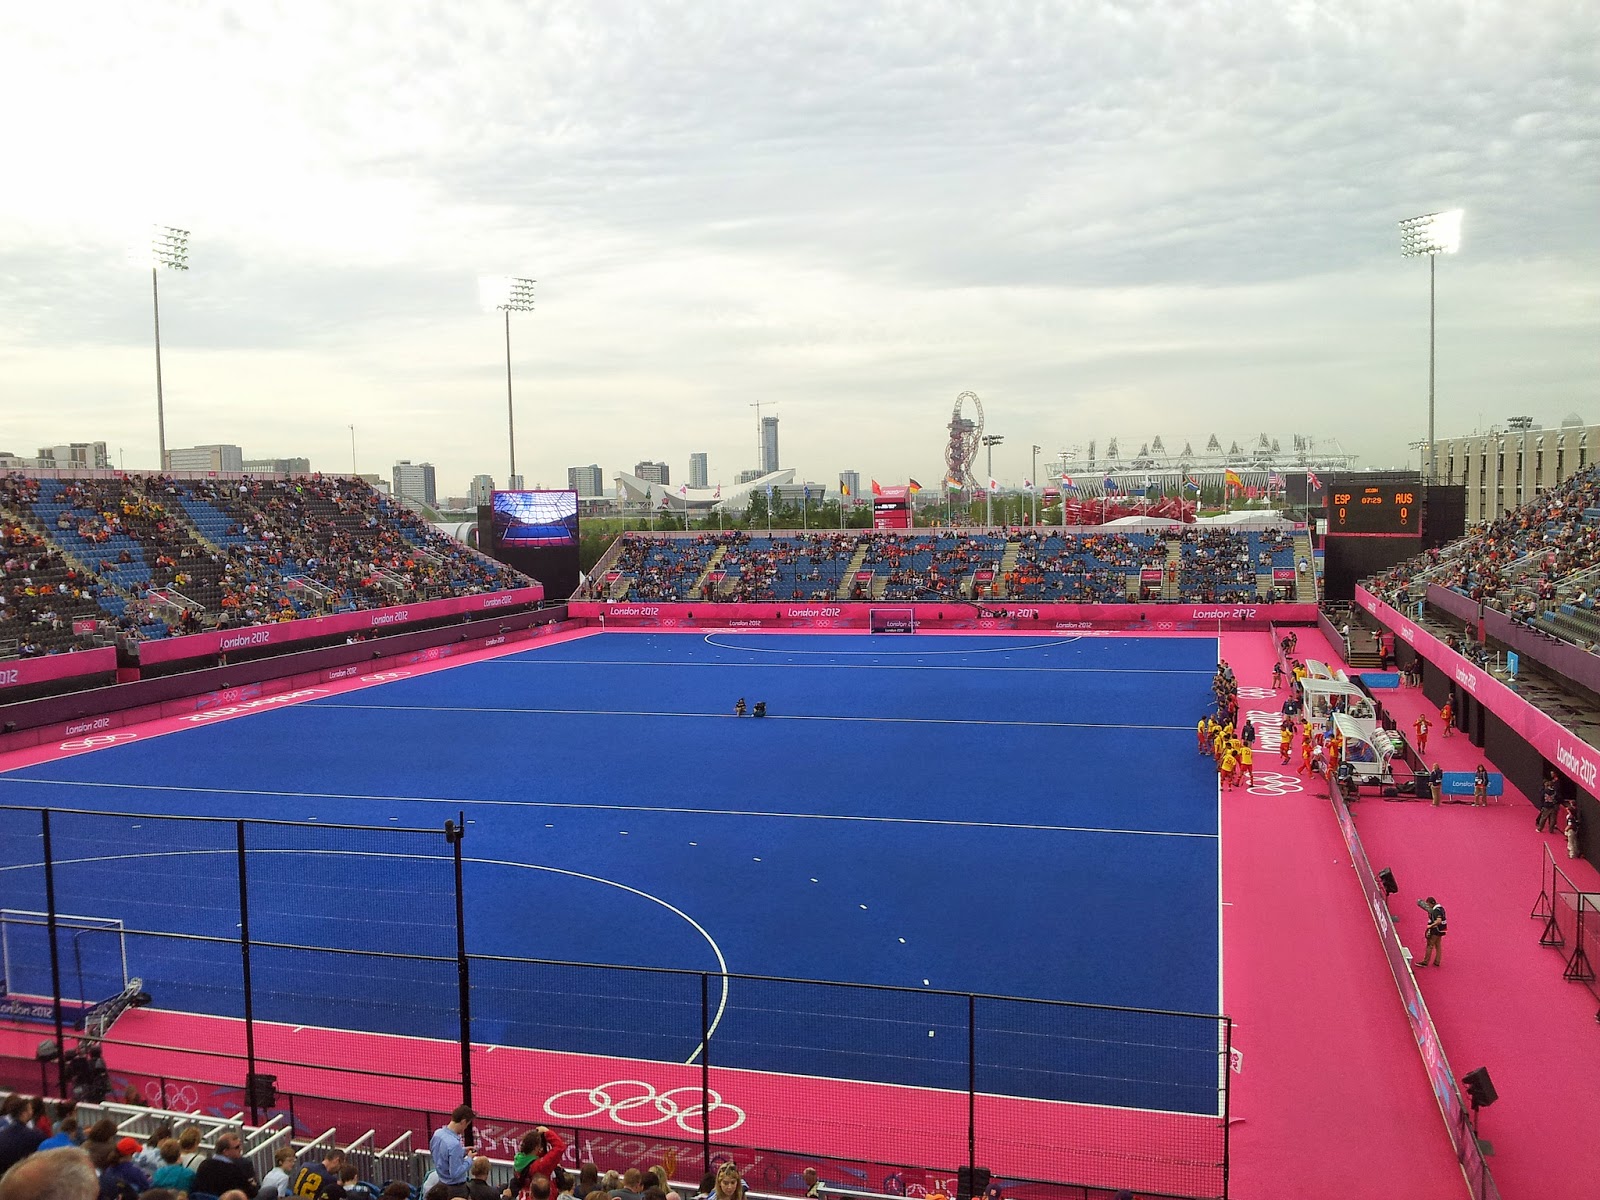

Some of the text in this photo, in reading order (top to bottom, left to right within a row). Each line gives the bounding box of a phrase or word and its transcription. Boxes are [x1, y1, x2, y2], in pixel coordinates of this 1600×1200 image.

[1335, 494, 1351, 505] ESP
[1395, 493, 1413, 504] AUS
[1340, 508, 1346, 518] 0
[1401, 508, 1407, 518] 0
[610, 607, 659, 616] London 2012
[788, 608, 841, 617] London 2012
[1192, 609, 1230, 619] London
[371, 610, 408, 625] London 2012
[220, 631, 270, 649] London 2012
[0, 670, 18, 684] 012
[329, 667, 357, 679] London 2012
[66, 717, 110, 735] London 2012
[1557, 739, 1597, 789] London 2012
[1452, 780, 1476, 788] London
[0, 1003, 53, 1019] ondon 2012
[293, 1167, 322, 1200] 12
